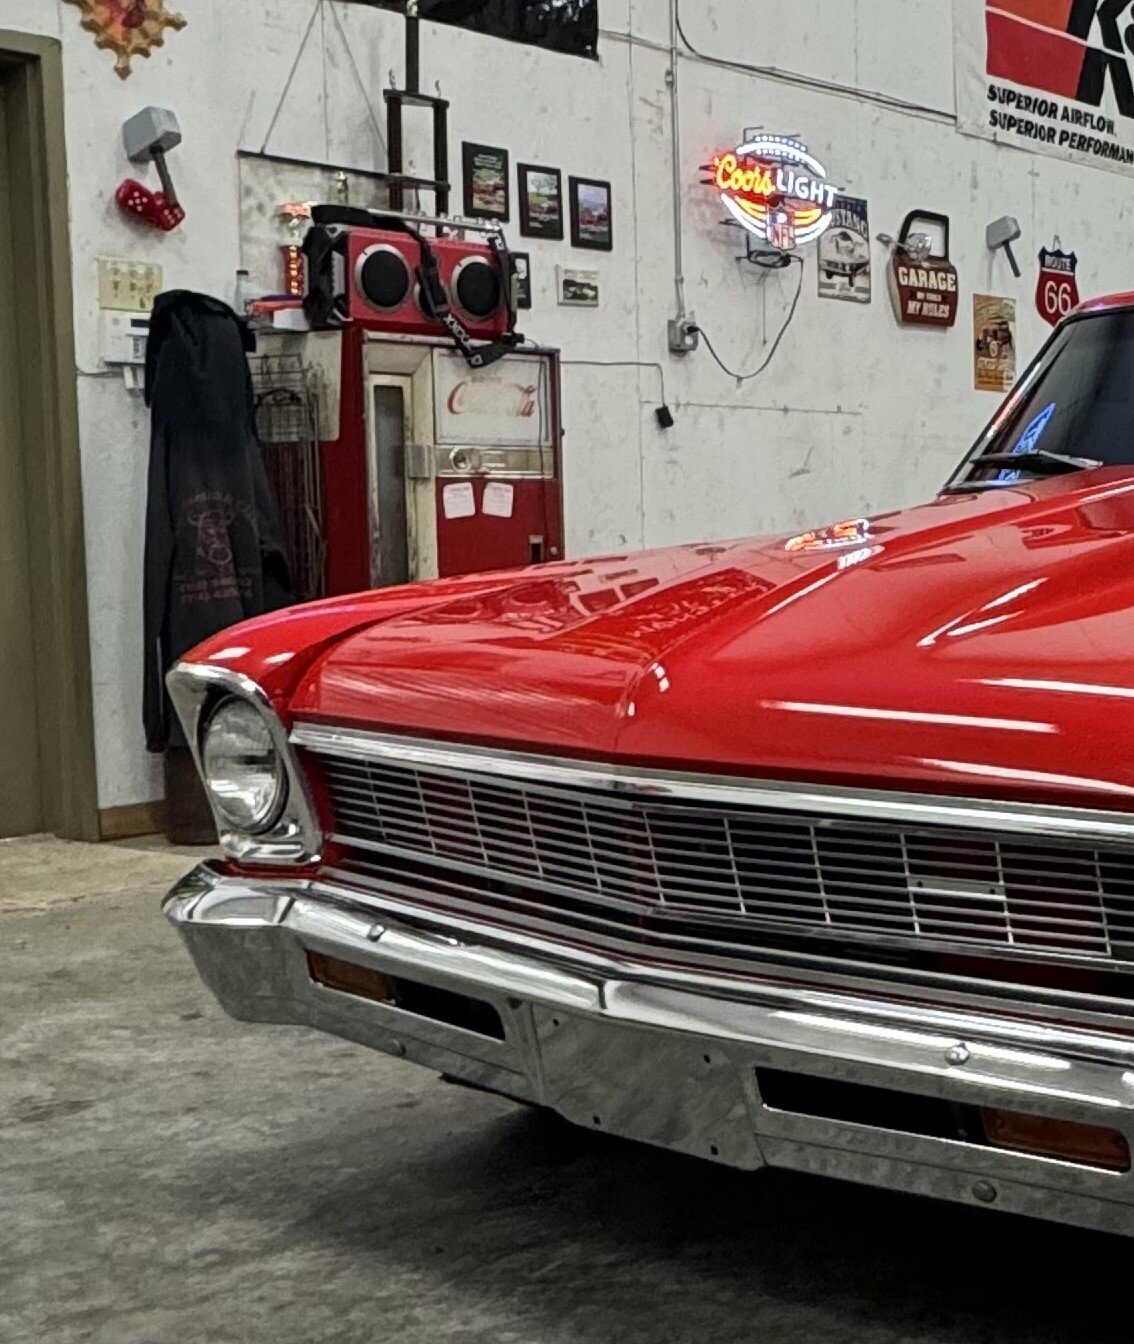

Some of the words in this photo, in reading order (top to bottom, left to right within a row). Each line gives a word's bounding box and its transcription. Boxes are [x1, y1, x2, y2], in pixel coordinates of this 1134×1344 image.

[987, 84, 1058, 119] SUPERIOR
[989, 109, 1057, 144] SUPERIOR
[716, 153, 776, 196] Coors
[776, 169, 838, 207] LIGHT
[898, 266, 956, 292] GARAGE
[1044, 255, 1072, 271] ROUTE
[1044, 280, 1072, 316] 66
